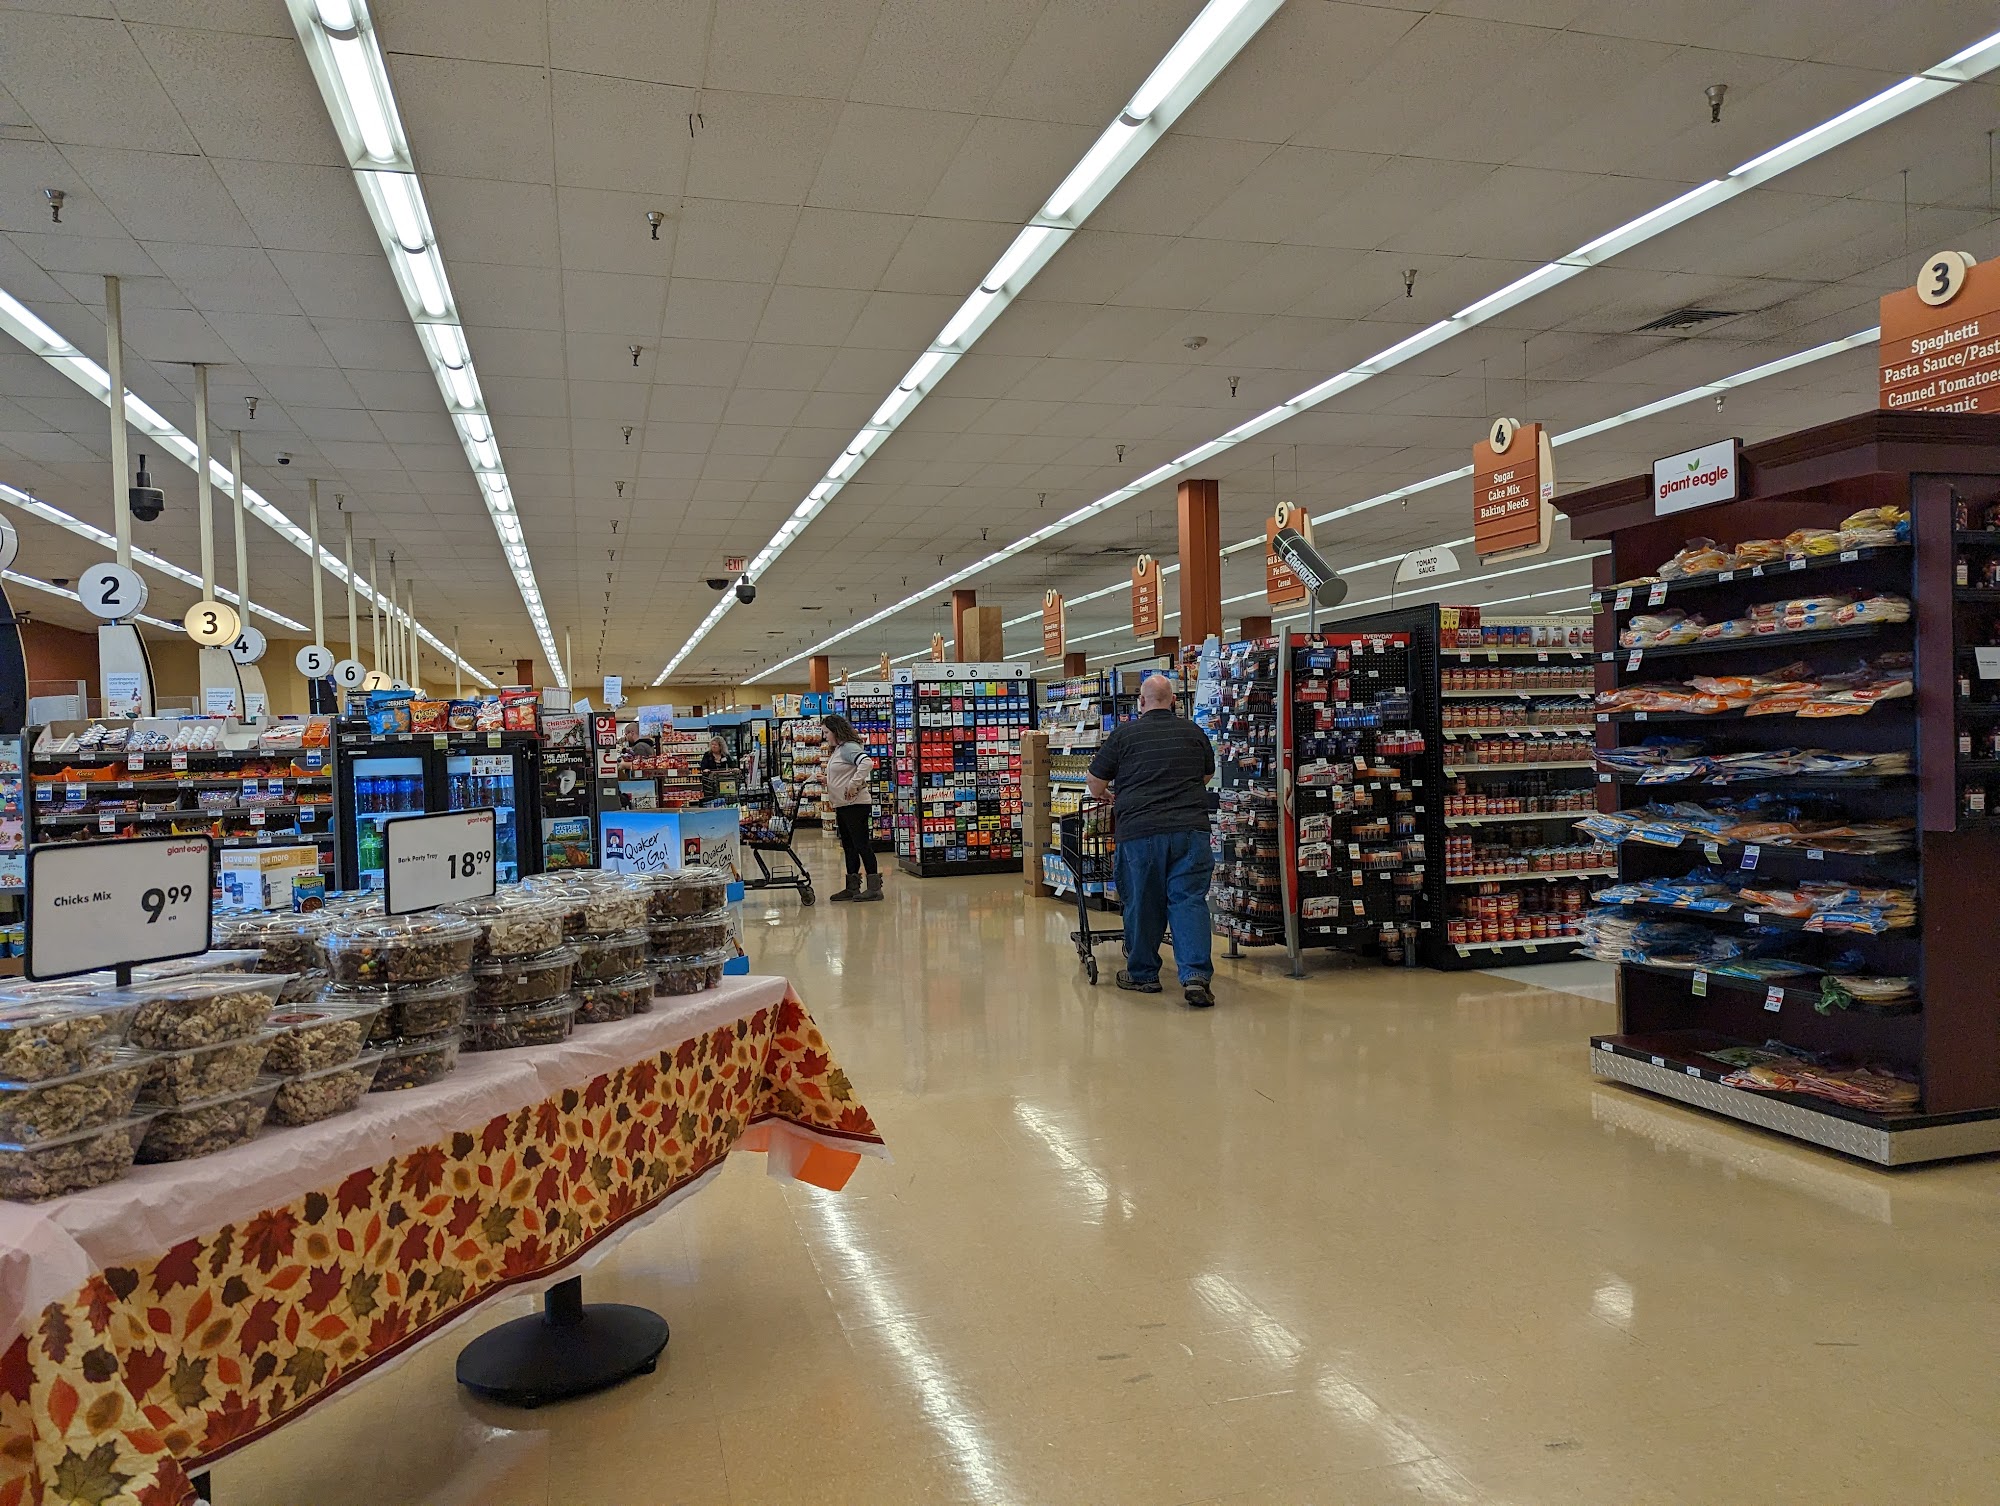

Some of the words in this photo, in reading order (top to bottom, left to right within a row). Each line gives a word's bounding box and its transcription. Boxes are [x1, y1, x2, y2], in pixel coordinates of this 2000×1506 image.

[1931, 262, 1950, 297] 3
[1911, 321, 1979, 354] Spaghetti
[1884, 363, 1920, 383] Pasta
[1888, 382, 1936, 407] Canned
[1495, 424, 1505, 446] 4
[1493, 470, 1514, 484] Sugar
[1659, 475, 1691, 498] giant
[1692, 466, 1728, 485] eagle
[1488, 487, 1505, 501] Cake
[1507, 484, 1521, 496] Mix
[1278, 507, 1284, 524] 5
[1481, 503, 1506, 518] Baking
[1507, 497, 1529, 511] Needs
[728, 559, 745, 571] EXIT
[1285, 549, 1321, 591] Energizer
[1416, 557, 1438, 567] TOMATO
[1418, 565, 1436, 575] SAUCE
[100, 576, 120, 604] 2
[1278, 577, 1291, 588] Cereal
[202, 611, 218, 635] 3
[234, 634, 249, 653] 4
[308, 653, 320, 670] 5
[345, 666, 356, 681] 6
[372, 677, 380, 689] 7
[546, 718, 585, 727] CHRISTMAS
[167, 844, 186, 856] giant
[186, 843, 208, 854] eagle
[624, 833, 660, 860] Quaker
[271, 854, 289, 862] more
[397, 856, 411, 864] Bark
[412, 855, 426, 863] Party
[426, 853, 438, 861] Tray
[633, 858, 646, 872] To
[54, 894, 90, 907] Chicks
[92, 890, 112, 902] Mix
